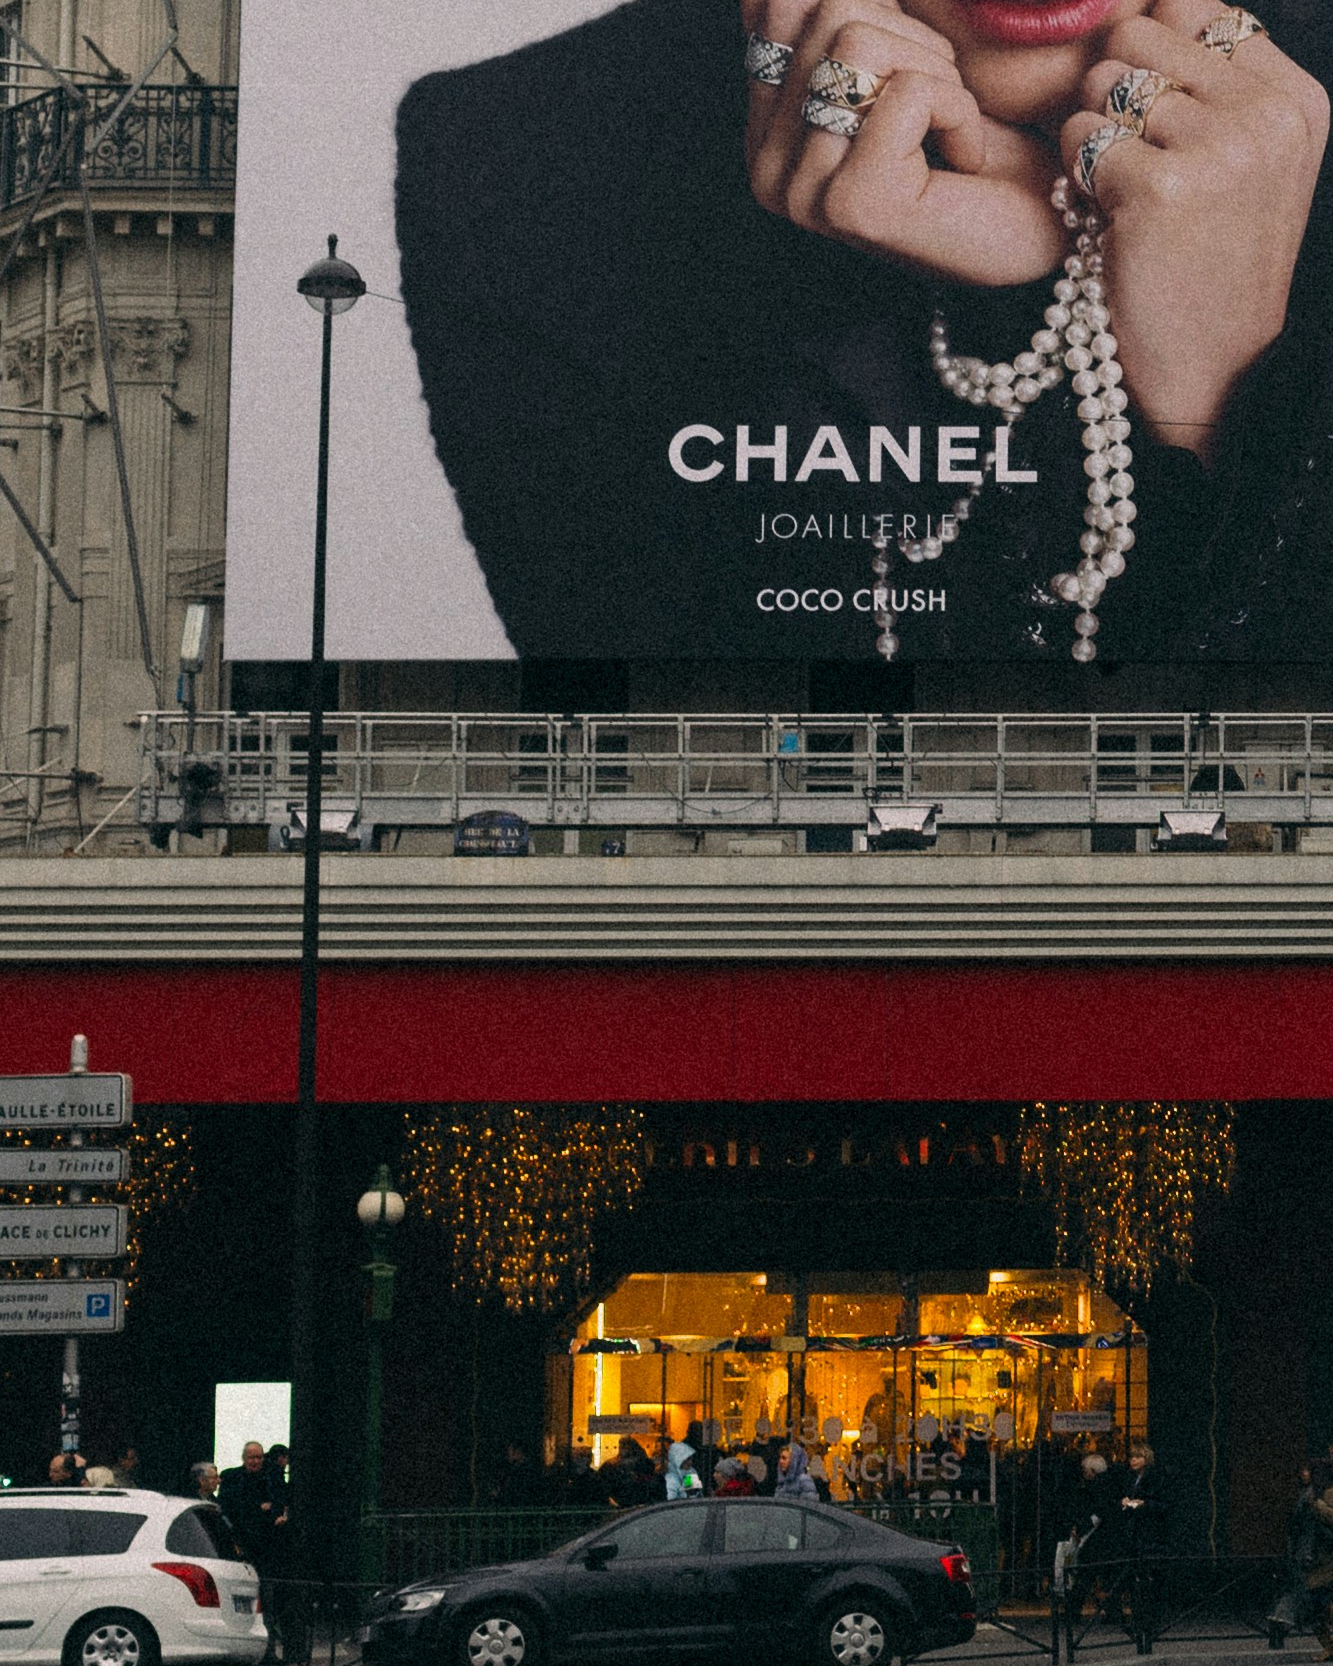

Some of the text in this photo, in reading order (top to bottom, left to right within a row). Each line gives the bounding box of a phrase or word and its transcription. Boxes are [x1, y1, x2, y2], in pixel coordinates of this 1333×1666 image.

[668, 423, 1039, 483] CHANEL
[755, 512, 960, 545] JOAILLERIE
[756, 588, 947, 612] COCO CRUSH
[28, 1158, 115, 1173] La Trinité
[52, 1223, 112, 1239] CLICHY
